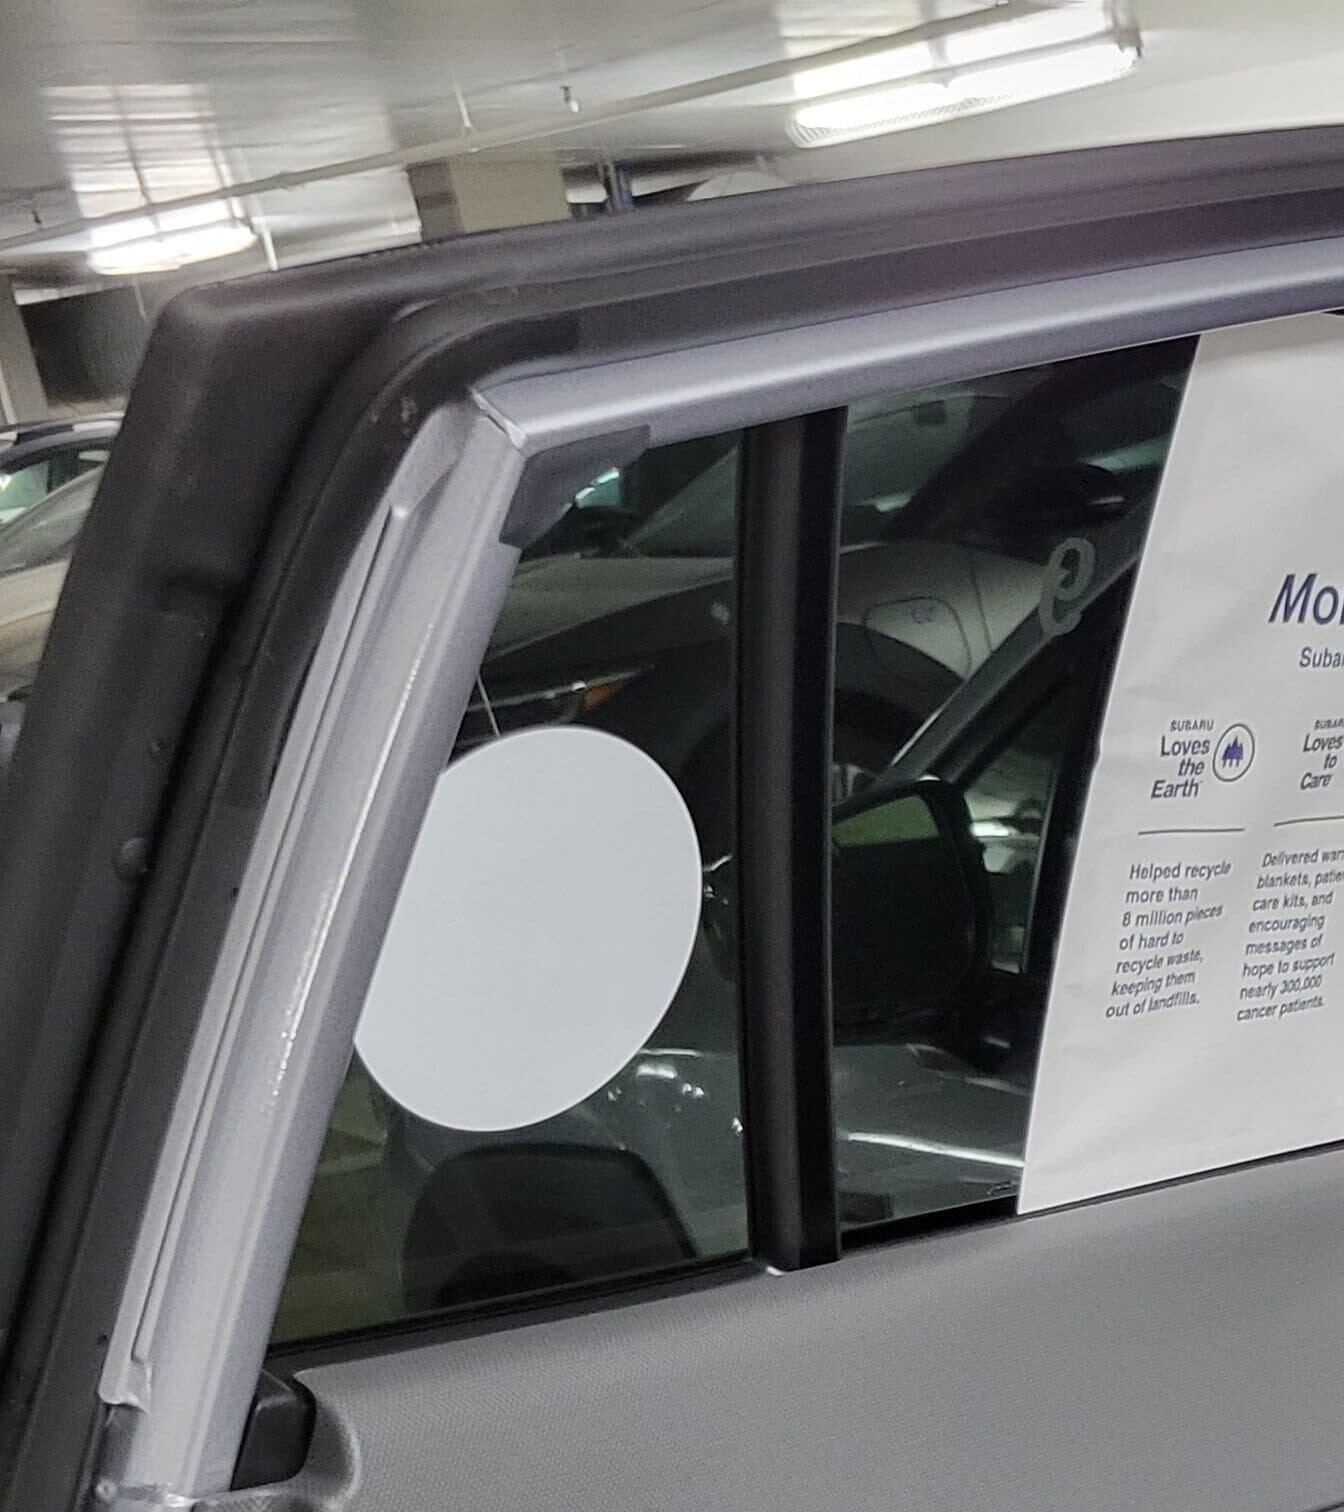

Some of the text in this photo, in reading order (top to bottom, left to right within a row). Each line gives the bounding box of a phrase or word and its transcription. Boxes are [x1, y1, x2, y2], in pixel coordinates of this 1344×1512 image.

[1170, 719, 1214, 731] SUBARU
[1160, 736, 1210, 756] Loves
[1303, 735, 1343, 752] Loves
[1178, 759, 1204, 776] the
[1324, 755, 1337, 770] to
[1150, 780, 1199, 798] Earth
[1300, 773, 1331, 790] Care
[1262, 850, 1318, 867] Delivered
[1130, 861, 1231, 882] Helped recycle
[1257, 873, 1312, 889] blankets,
[1126, 888, 1198, 903] more than
[1253, 892, 1333, 911] care kits, and
[1122, 905, 1223, 927] 8 million pieces
[1249, 916, 1324, 933] encouraging
[1119, 932, 1184, 950] of hard to
[1245, 934, 1323, 956] messages of
[1116, 950, 1203, 974] recycle waste,
[1243, 952, 1335, 979] hope to support
[1111, 972, 1196, 997] keeping them
[1240, 982, 1276, 999] nearly
[1106, 992, 1200, 1018] out of landfills.
[1237, 1006, 1276, 1021] cancer
